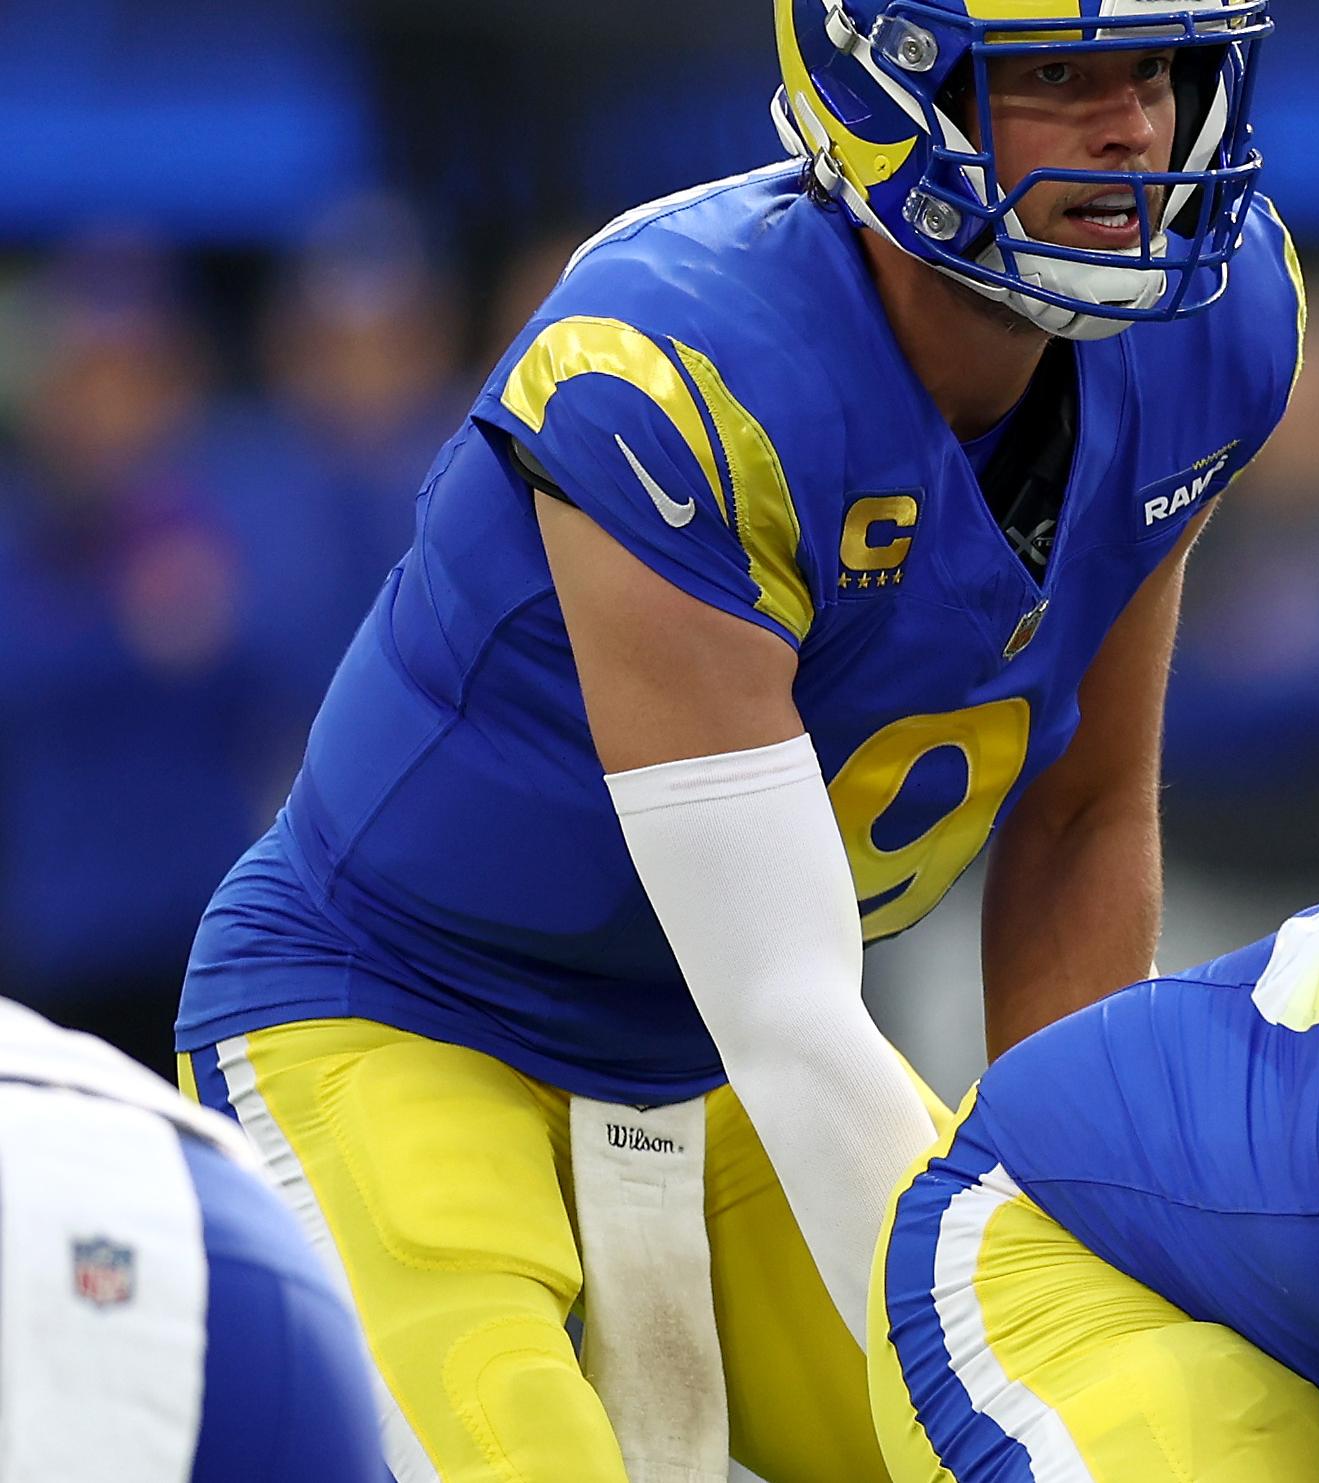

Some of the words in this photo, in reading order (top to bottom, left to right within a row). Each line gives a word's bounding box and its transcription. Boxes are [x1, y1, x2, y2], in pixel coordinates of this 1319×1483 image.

[839, 495, 918, 571] C
[826, 696, 1031, 941] 9
[606, 1123, 676, 1154] Wilson
